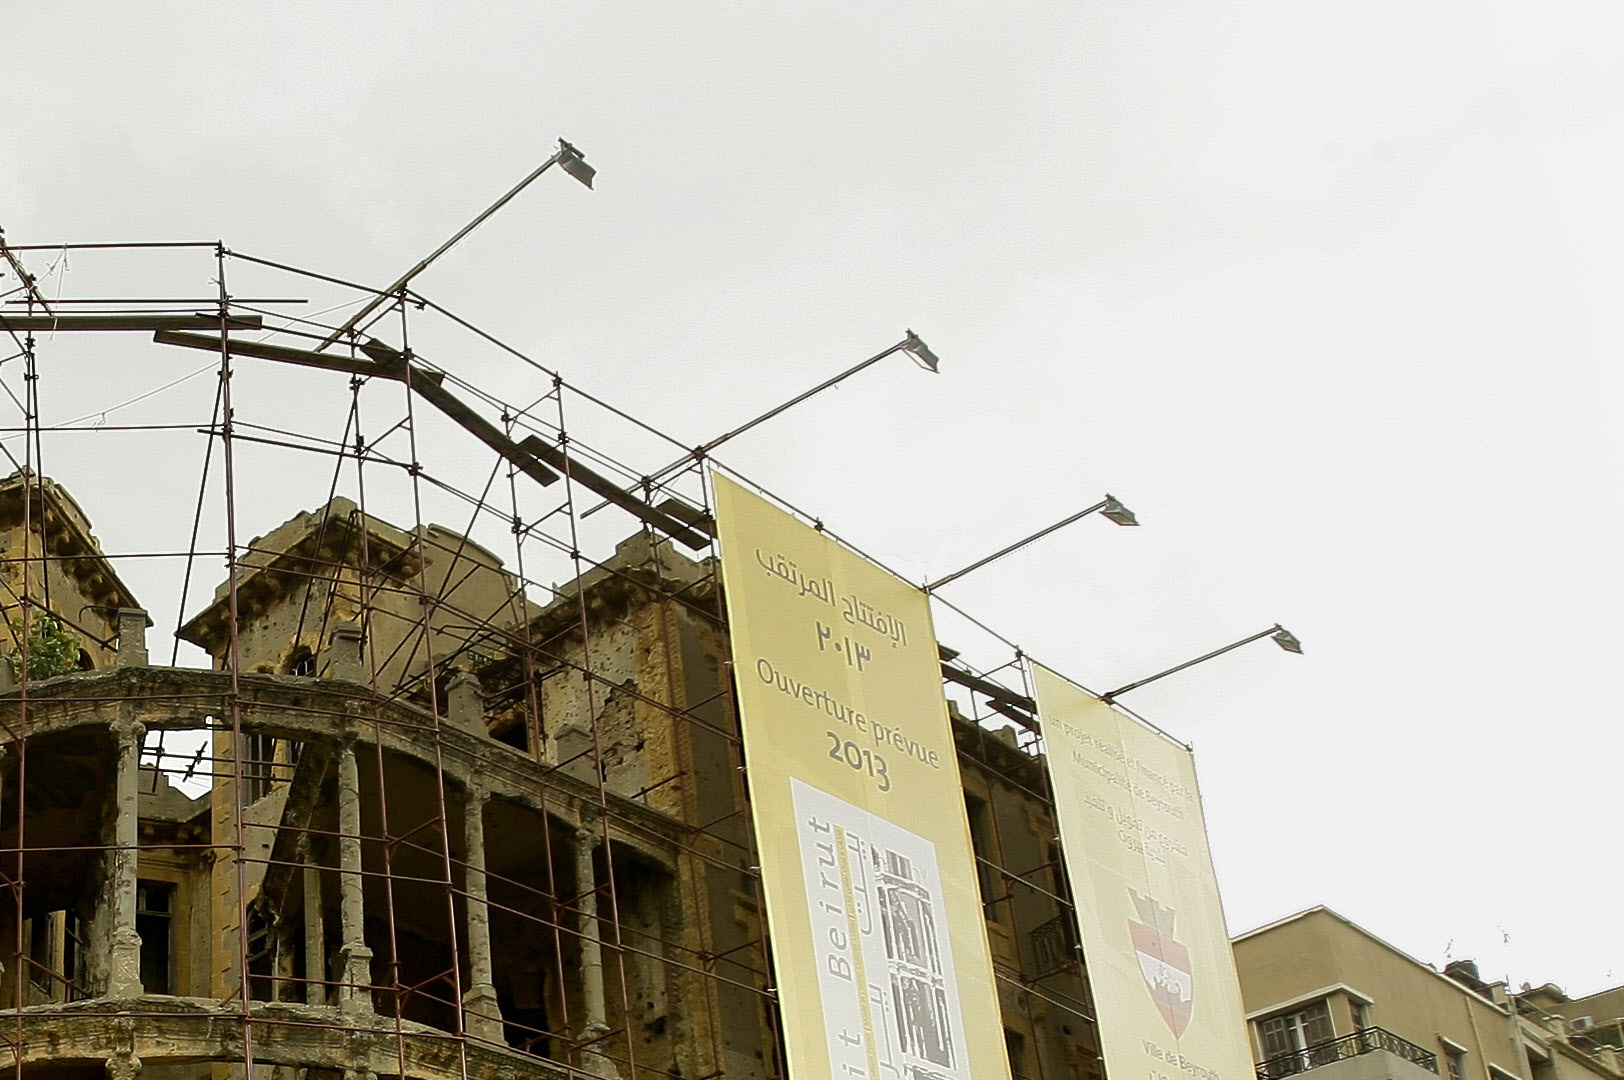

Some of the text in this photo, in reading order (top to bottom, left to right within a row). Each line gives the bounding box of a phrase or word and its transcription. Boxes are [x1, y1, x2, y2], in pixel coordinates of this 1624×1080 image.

[756, 549, 908, 649] الإفتتاح المرتقب
[815, 621, 872, 672] ٢٠١٣
[757, 658, 940, 770] Ouverture prévue
[826, 730, 892, 793] 2013
[807, 816, 853, 983] Beirut
